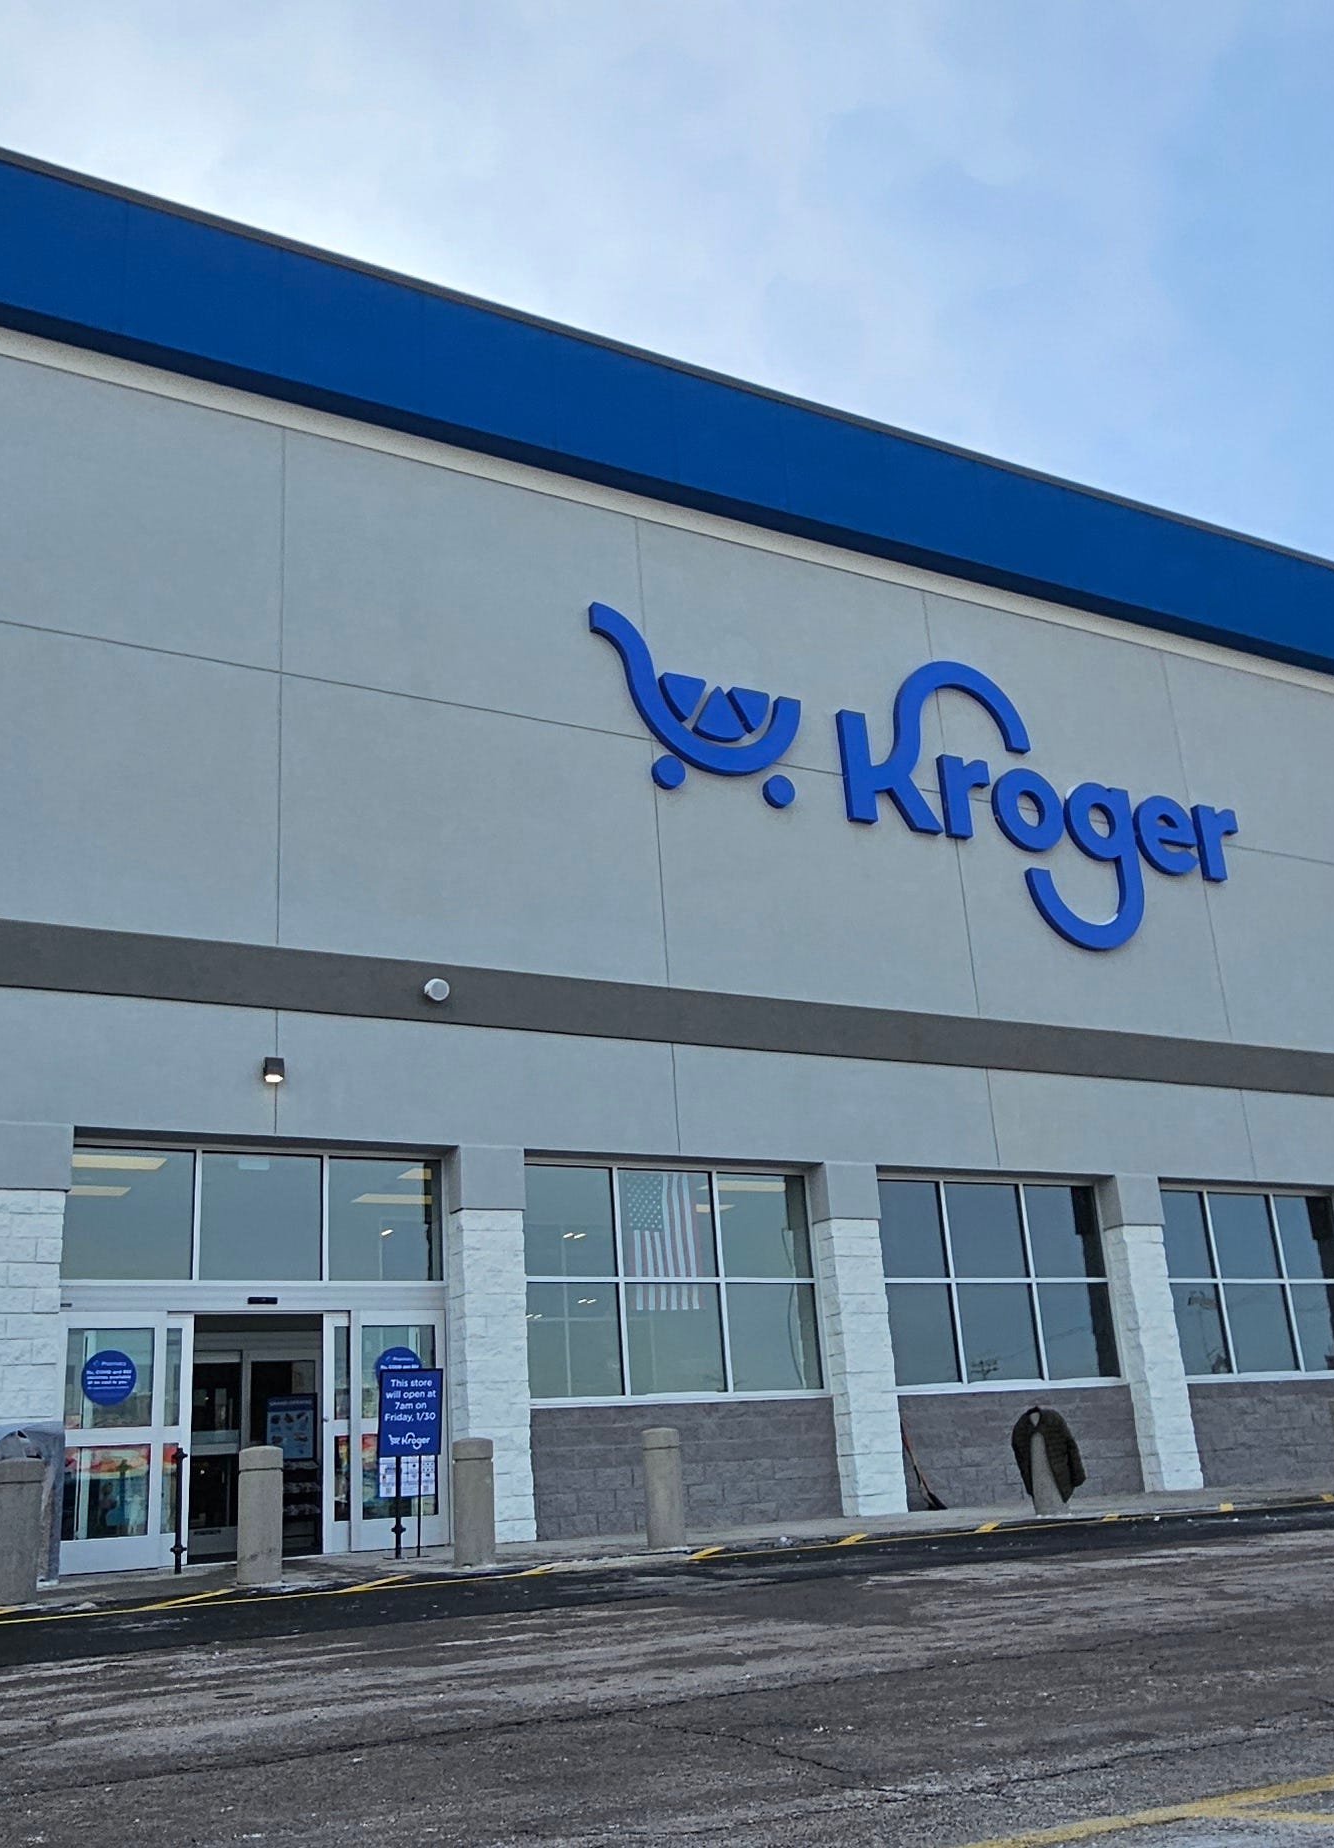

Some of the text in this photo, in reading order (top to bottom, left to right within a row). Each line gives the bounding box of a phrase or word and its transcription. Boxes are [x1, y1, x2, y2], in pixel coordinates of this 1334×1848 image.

[835, 660, 1238, 951] Kroger
[390, 1379, 433, 1387] This store
[385, 1390, 436, 1399] will open at
[394, 1401, 414, 1410] 7am
[384, 1412, 436, 1423] Friday, 1/30
[401, 1432, 431, 1450] Kroger
